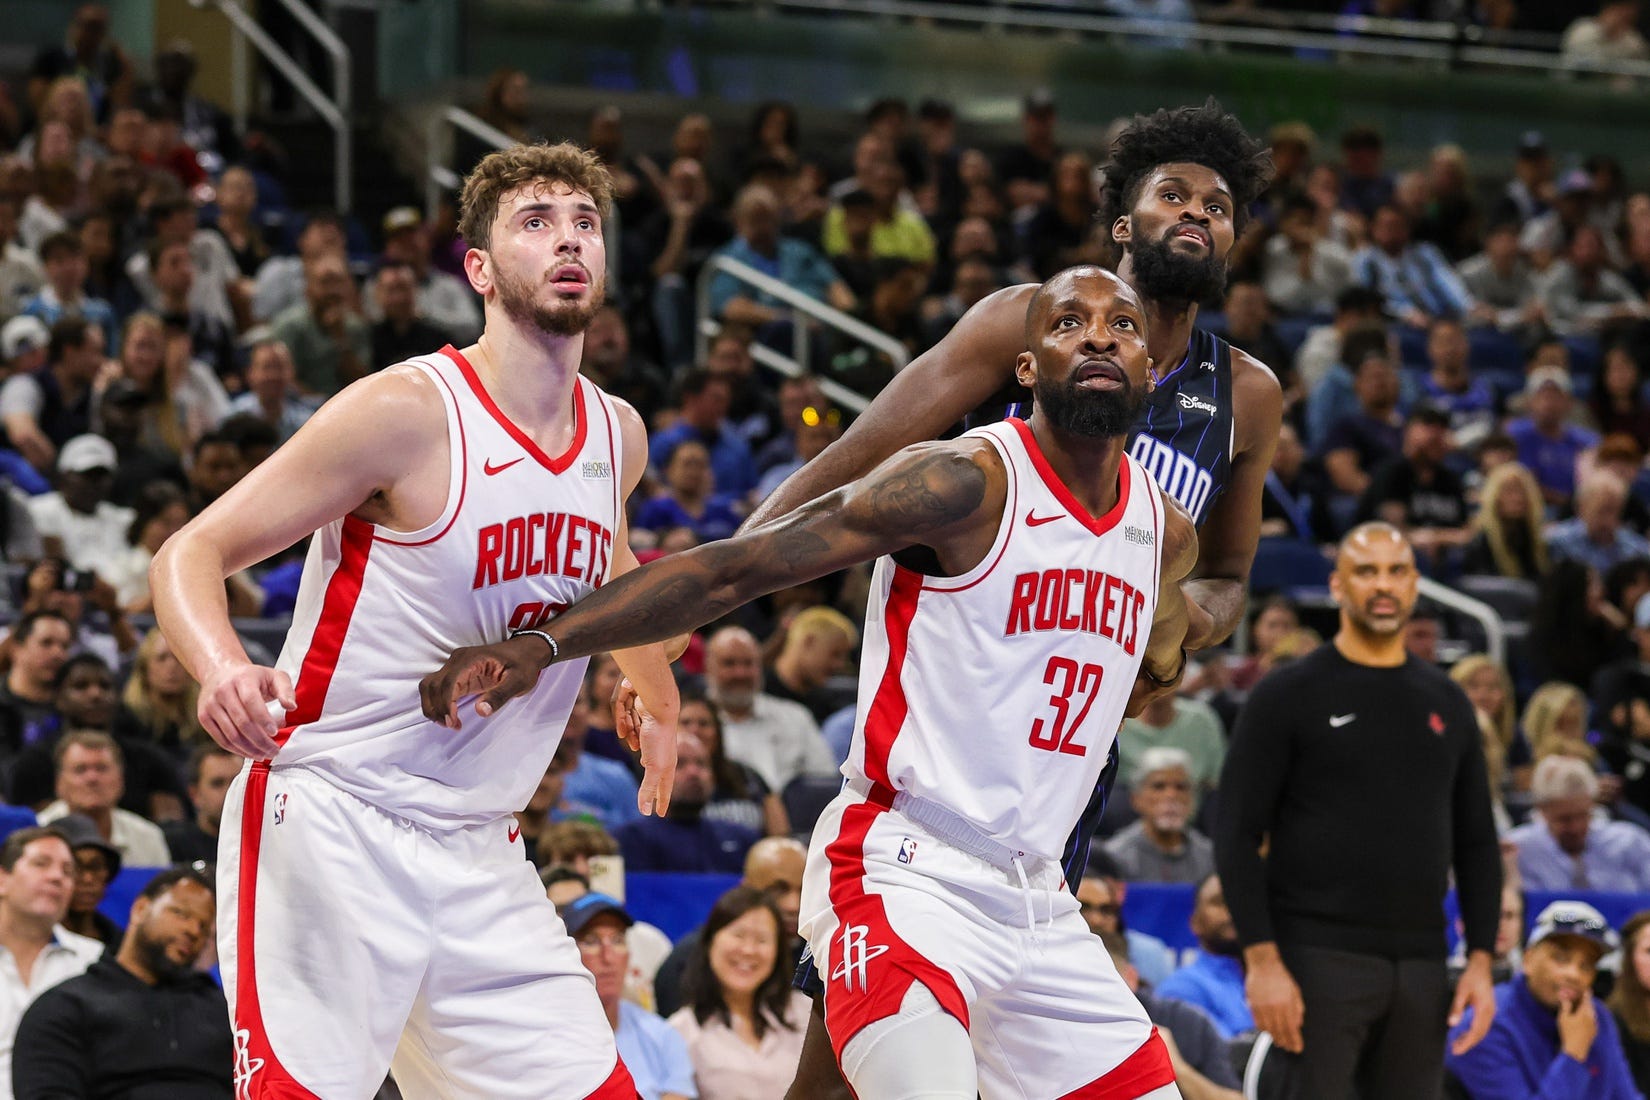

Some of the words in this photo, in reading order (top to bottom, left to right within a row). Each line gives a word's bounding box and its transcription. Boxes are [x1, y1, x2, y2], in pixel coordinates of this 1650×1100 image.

[1176, 392, 1217, 417] Disney
[1200, 361, 1216, 372] PW
[472, 512, 612, 590] ROCKETS
[1004, 568, 1145, 656] ROCKETS
[1028, 655, 1104, 757] 32
